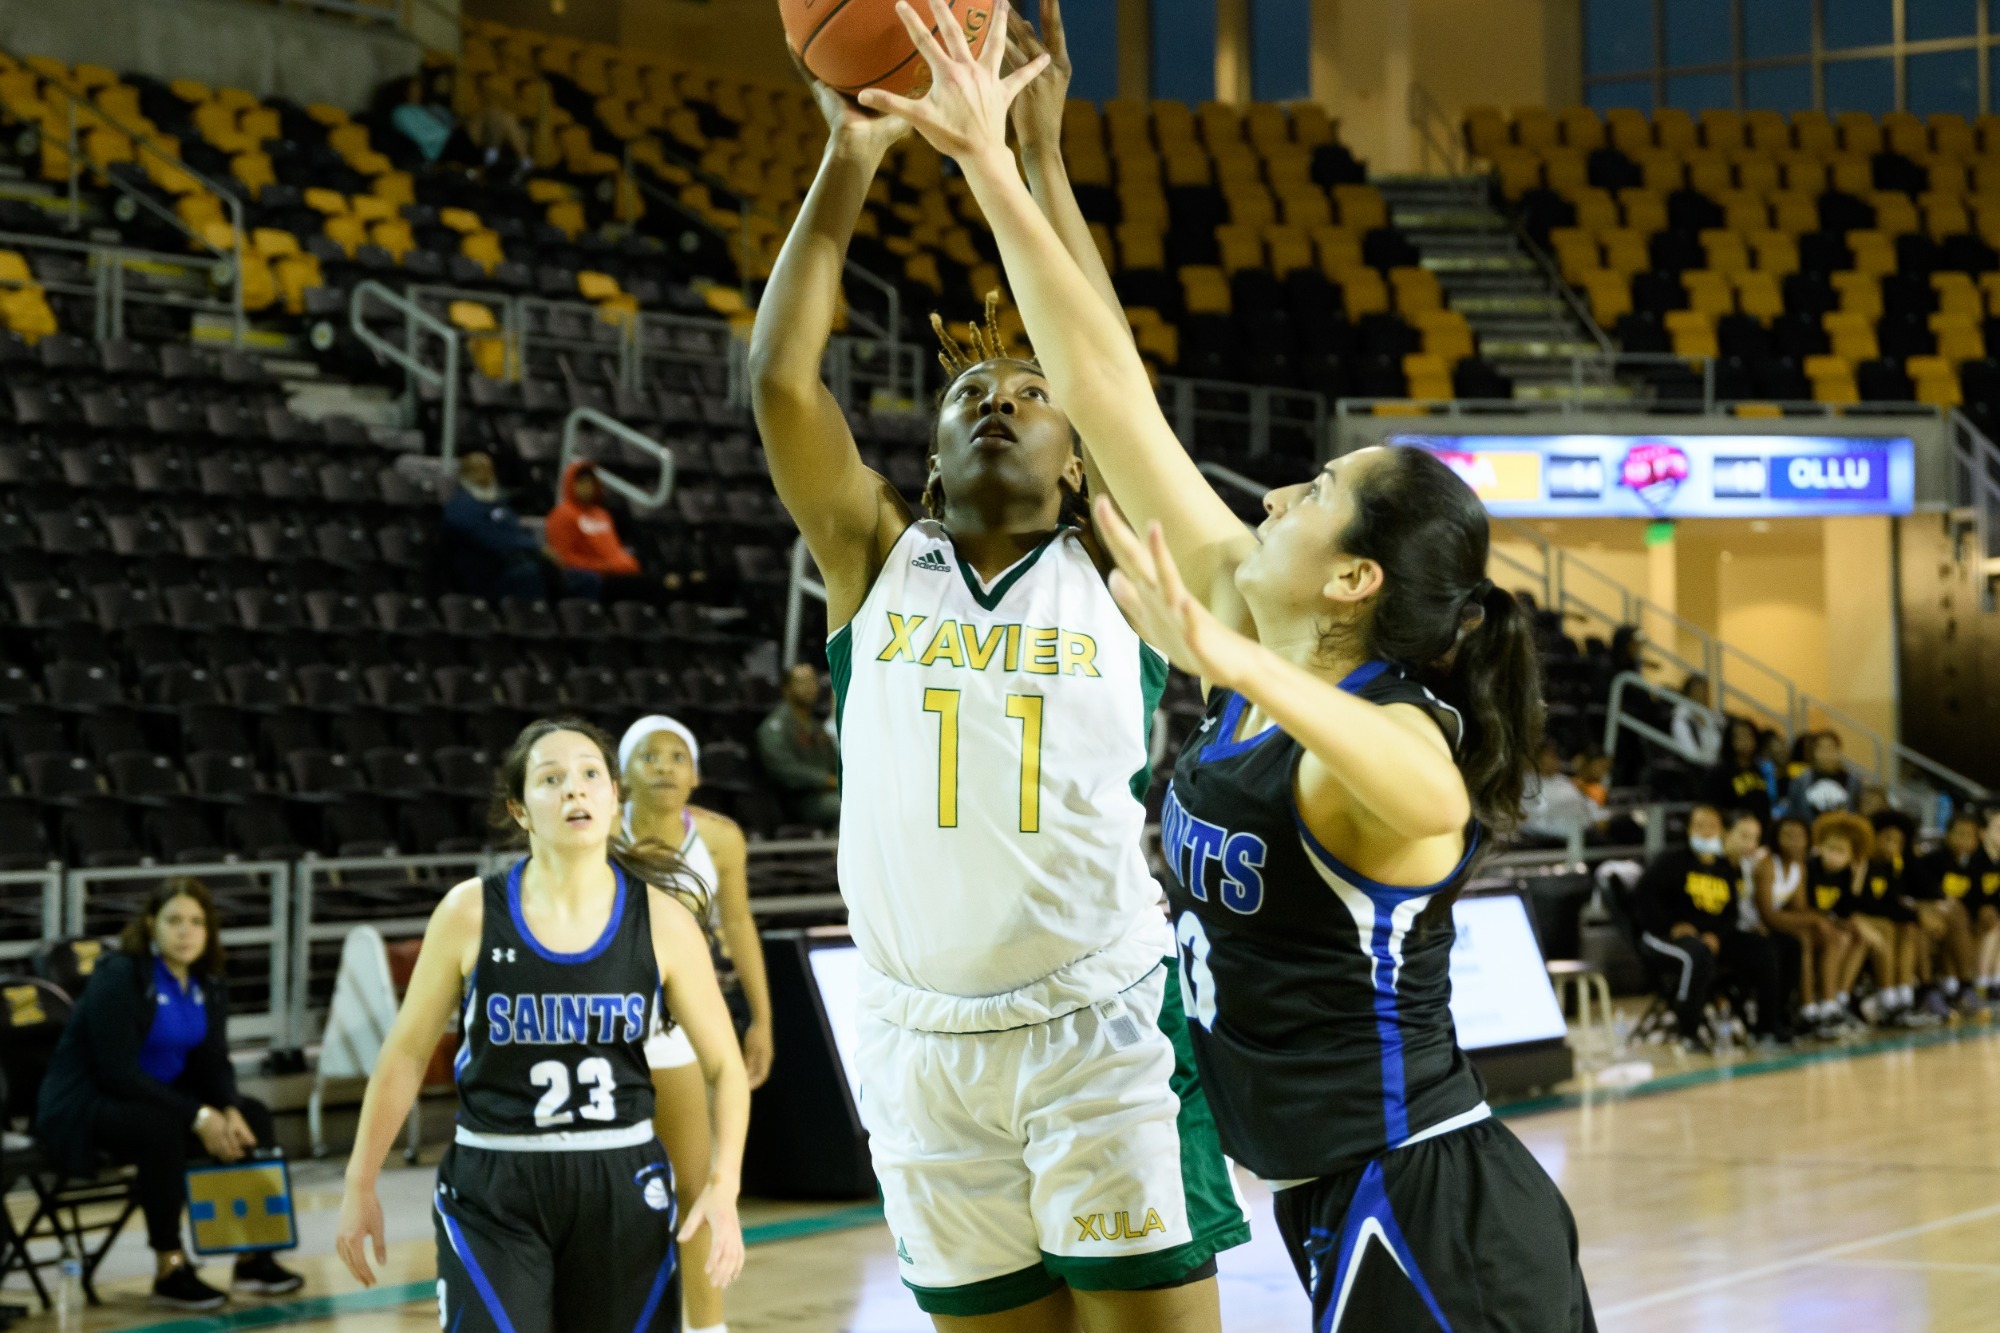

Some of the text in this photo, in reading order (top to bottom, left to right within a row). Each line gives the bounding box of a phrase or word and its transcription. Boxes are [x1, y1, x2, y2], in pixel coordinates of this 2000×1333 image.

[1788, 457, 1870, 490] OLLU
[911, 560, 951, 573] adidas
[876, 611, 1102, 678] XAVIER
[922, 687, 1044, 833] 11
[486, 993, 645, 1045] SAINTS
[530, 1057, 617, 1127] 23
[1073, 1208, 1166, 1241] XULA
